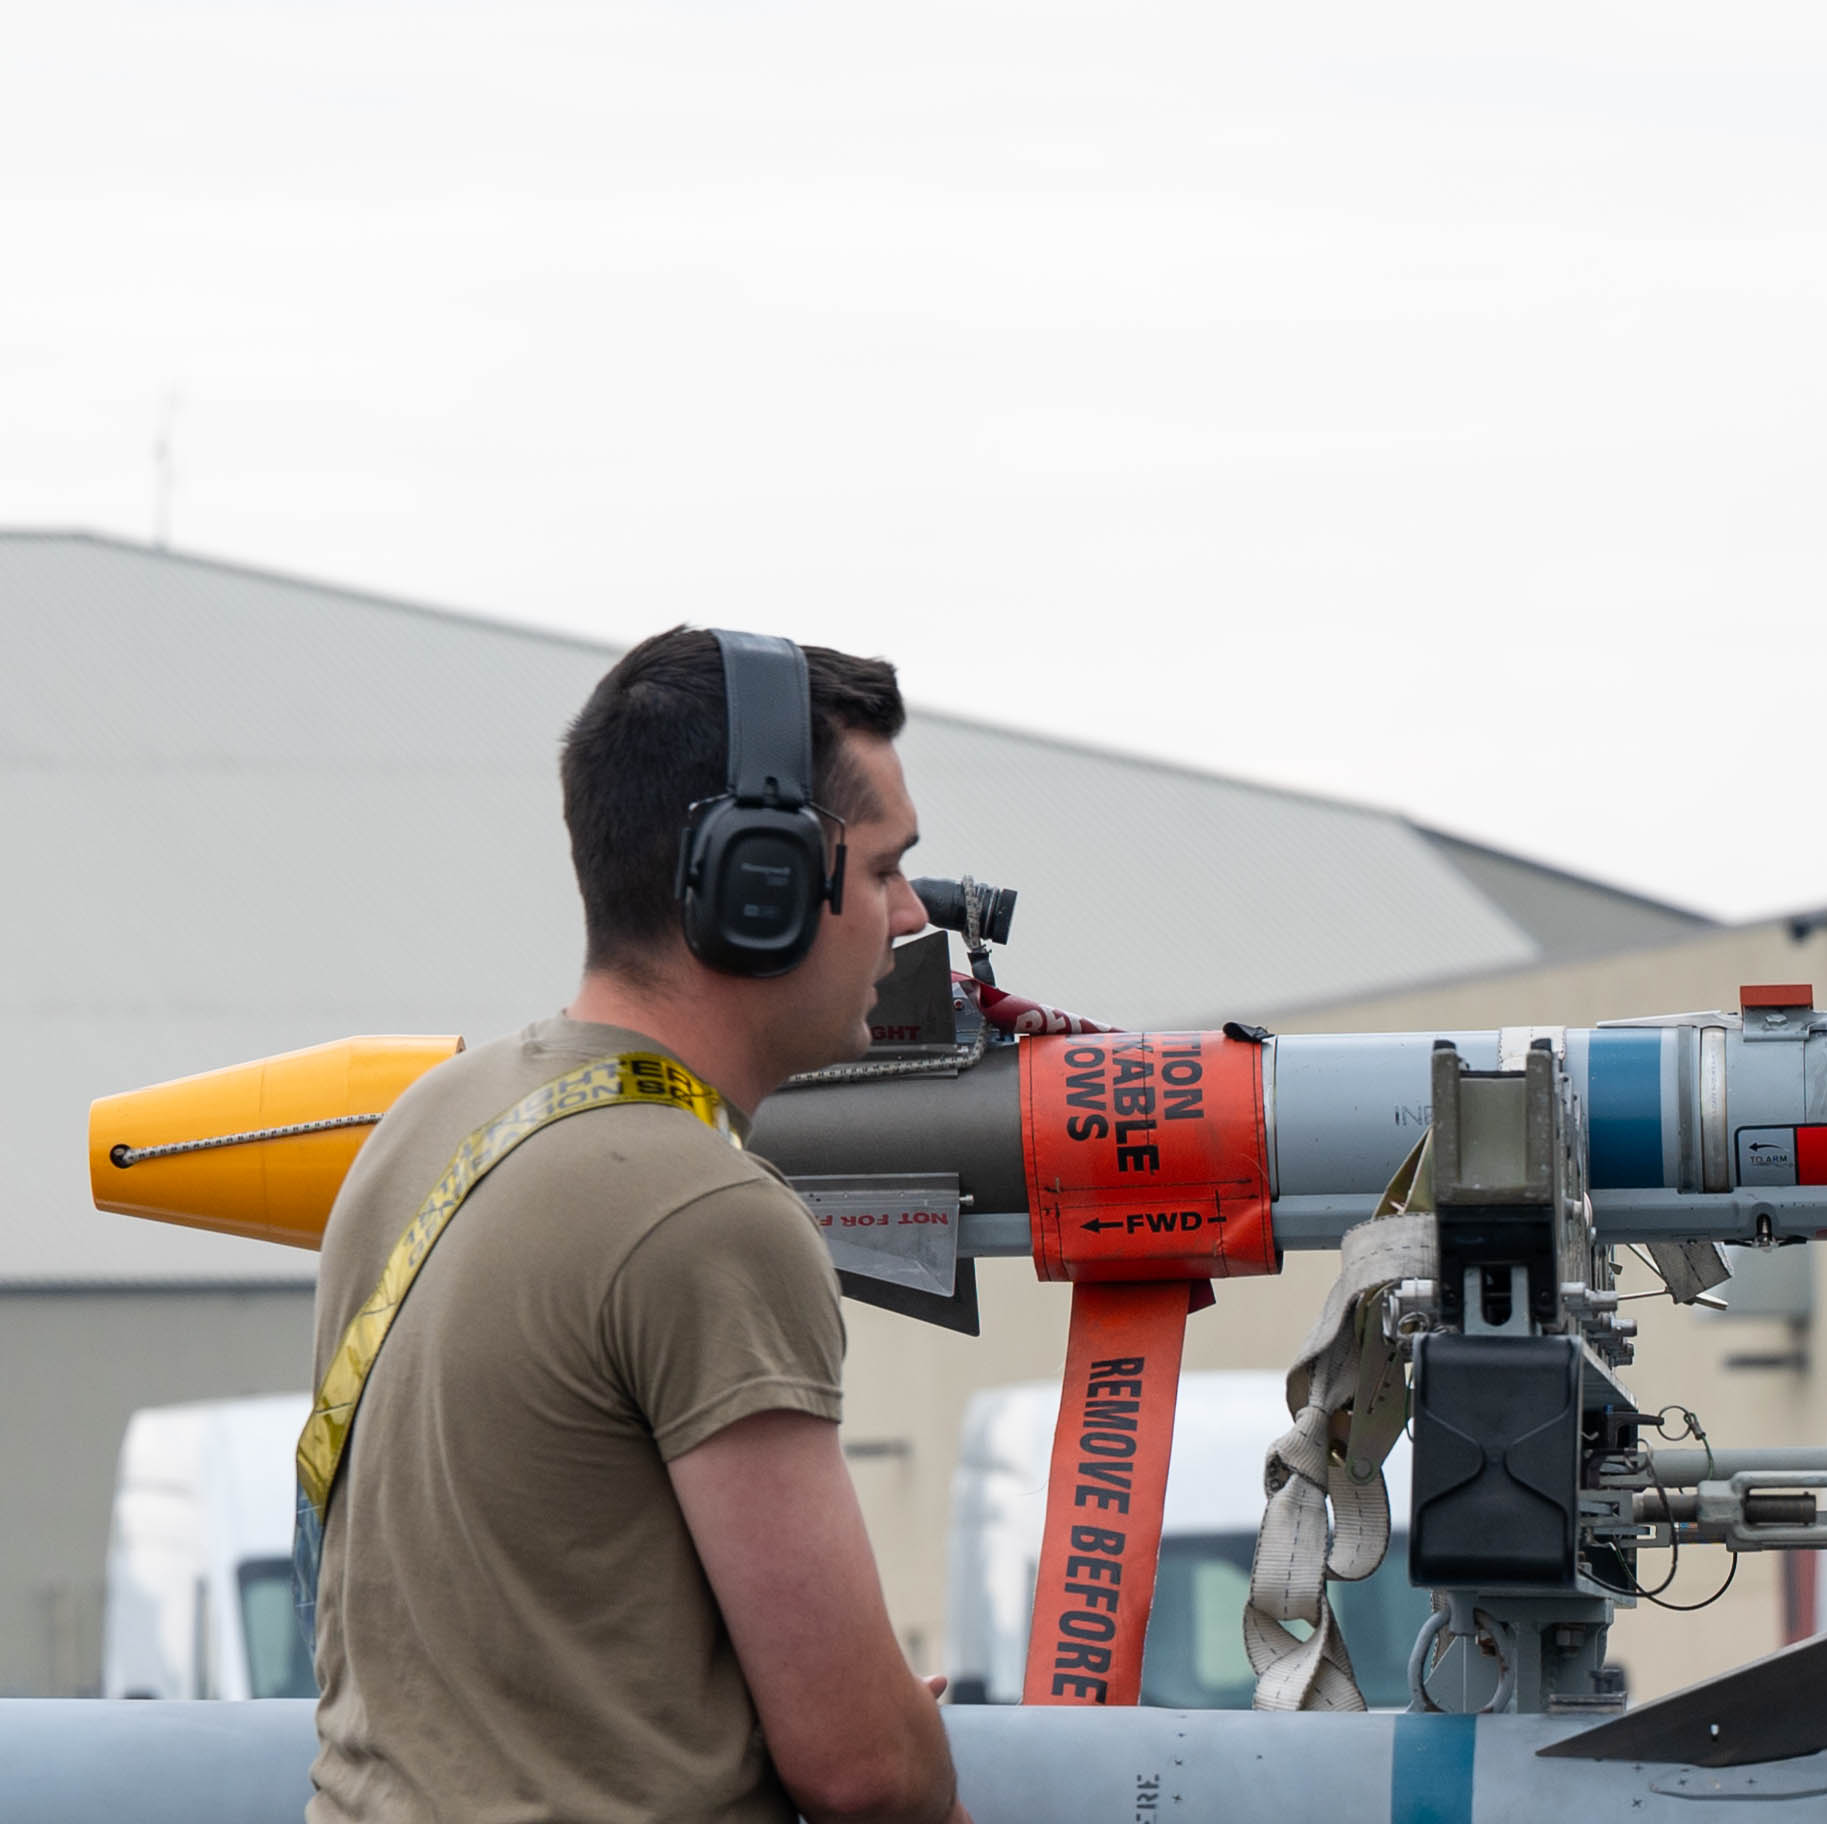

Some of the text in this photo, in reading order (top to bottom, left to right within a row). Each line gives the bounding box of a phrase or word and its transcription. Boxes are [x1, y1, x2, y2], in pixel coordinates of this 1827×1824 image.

[840, 1213, 893, 1227] FOR
[897, 1212, 948, 1226] NOT
[1126, 1211, 1203, 1234] FWD
[1051, 1357, 1145, 1705] REMOVE BEFORE
